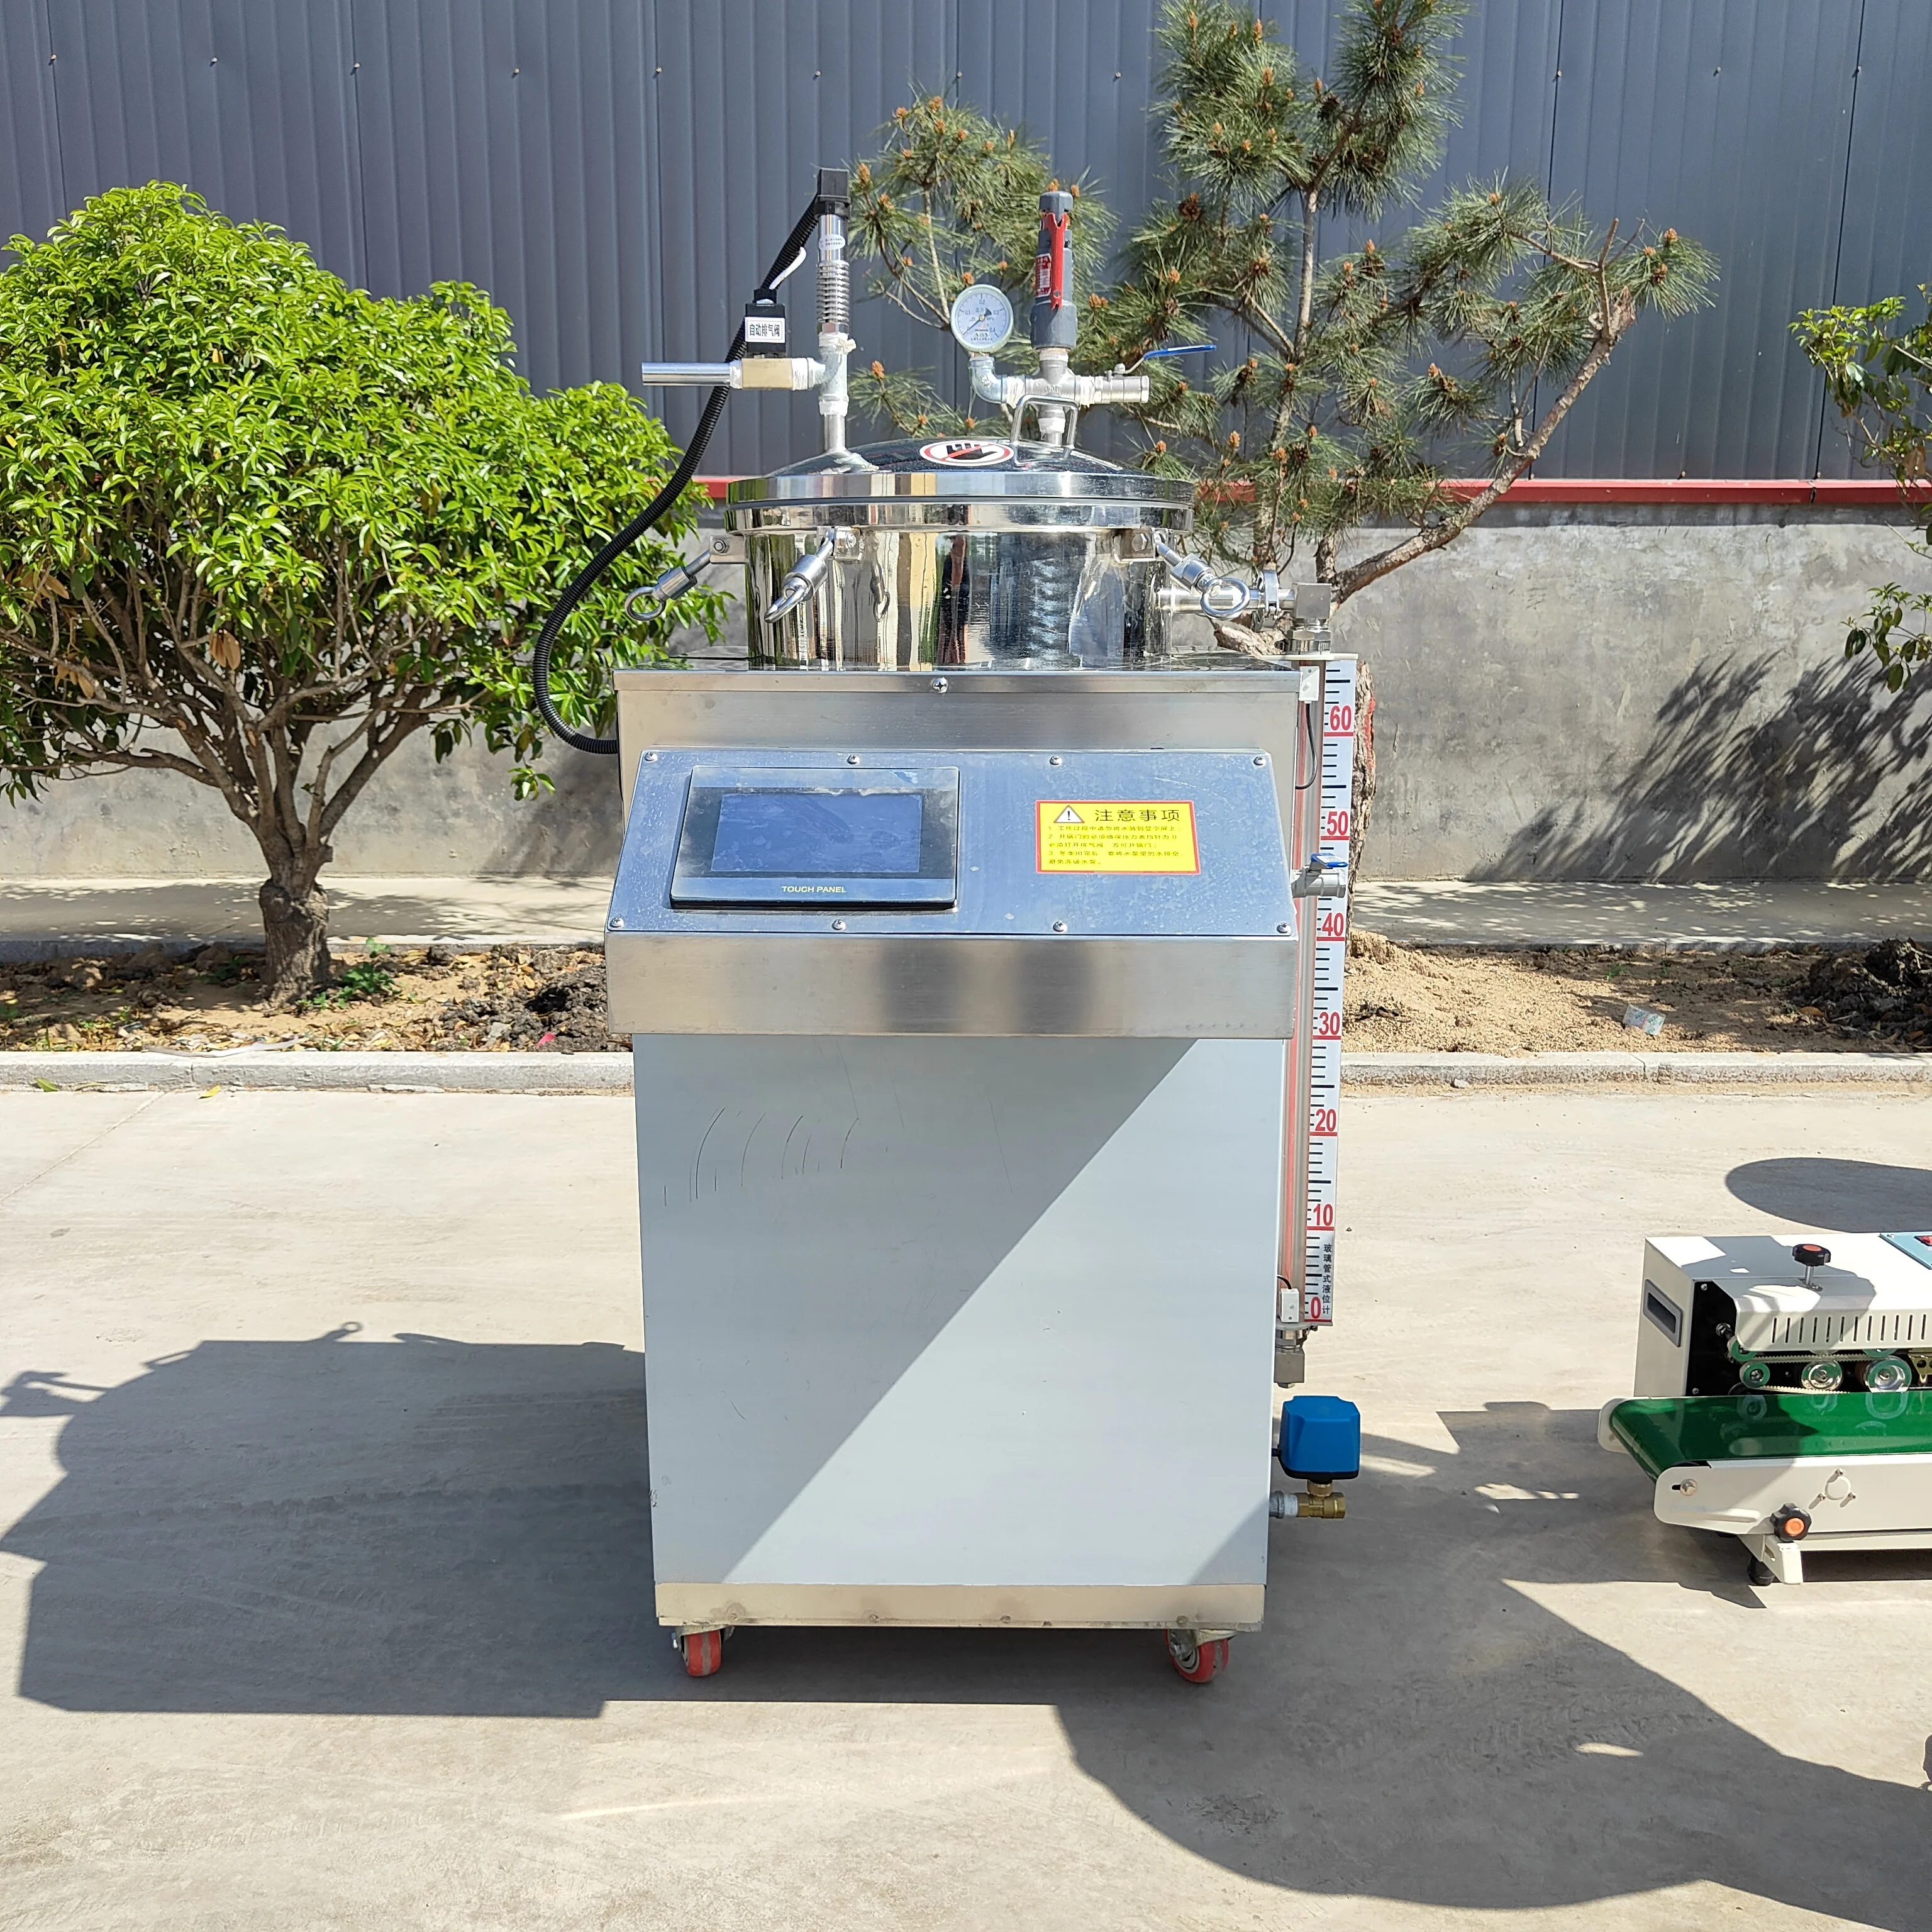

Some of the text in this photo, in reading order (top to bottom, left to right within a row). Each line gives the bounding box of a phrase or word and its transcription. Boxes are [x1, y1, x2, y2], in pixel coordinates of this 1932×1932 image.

[750, 323, 780, 337] 自动排气阀
[1330, 705, 1352, 731] 60
[1095, 809, 1180, 822] 注意事项
[1326, 811, 1348, 835] 50
[1321, 913, 1344, 936] 40
[1318, 1011, 1340, 1035] 30
[1314, 1109, 1337, 1132] 20
[1313, 1203, 1333, 1226] 10
[1321, 1243, 1332, 1315] 玻璃管式液位计
[1310, 1296, 1321, 1319] 0
